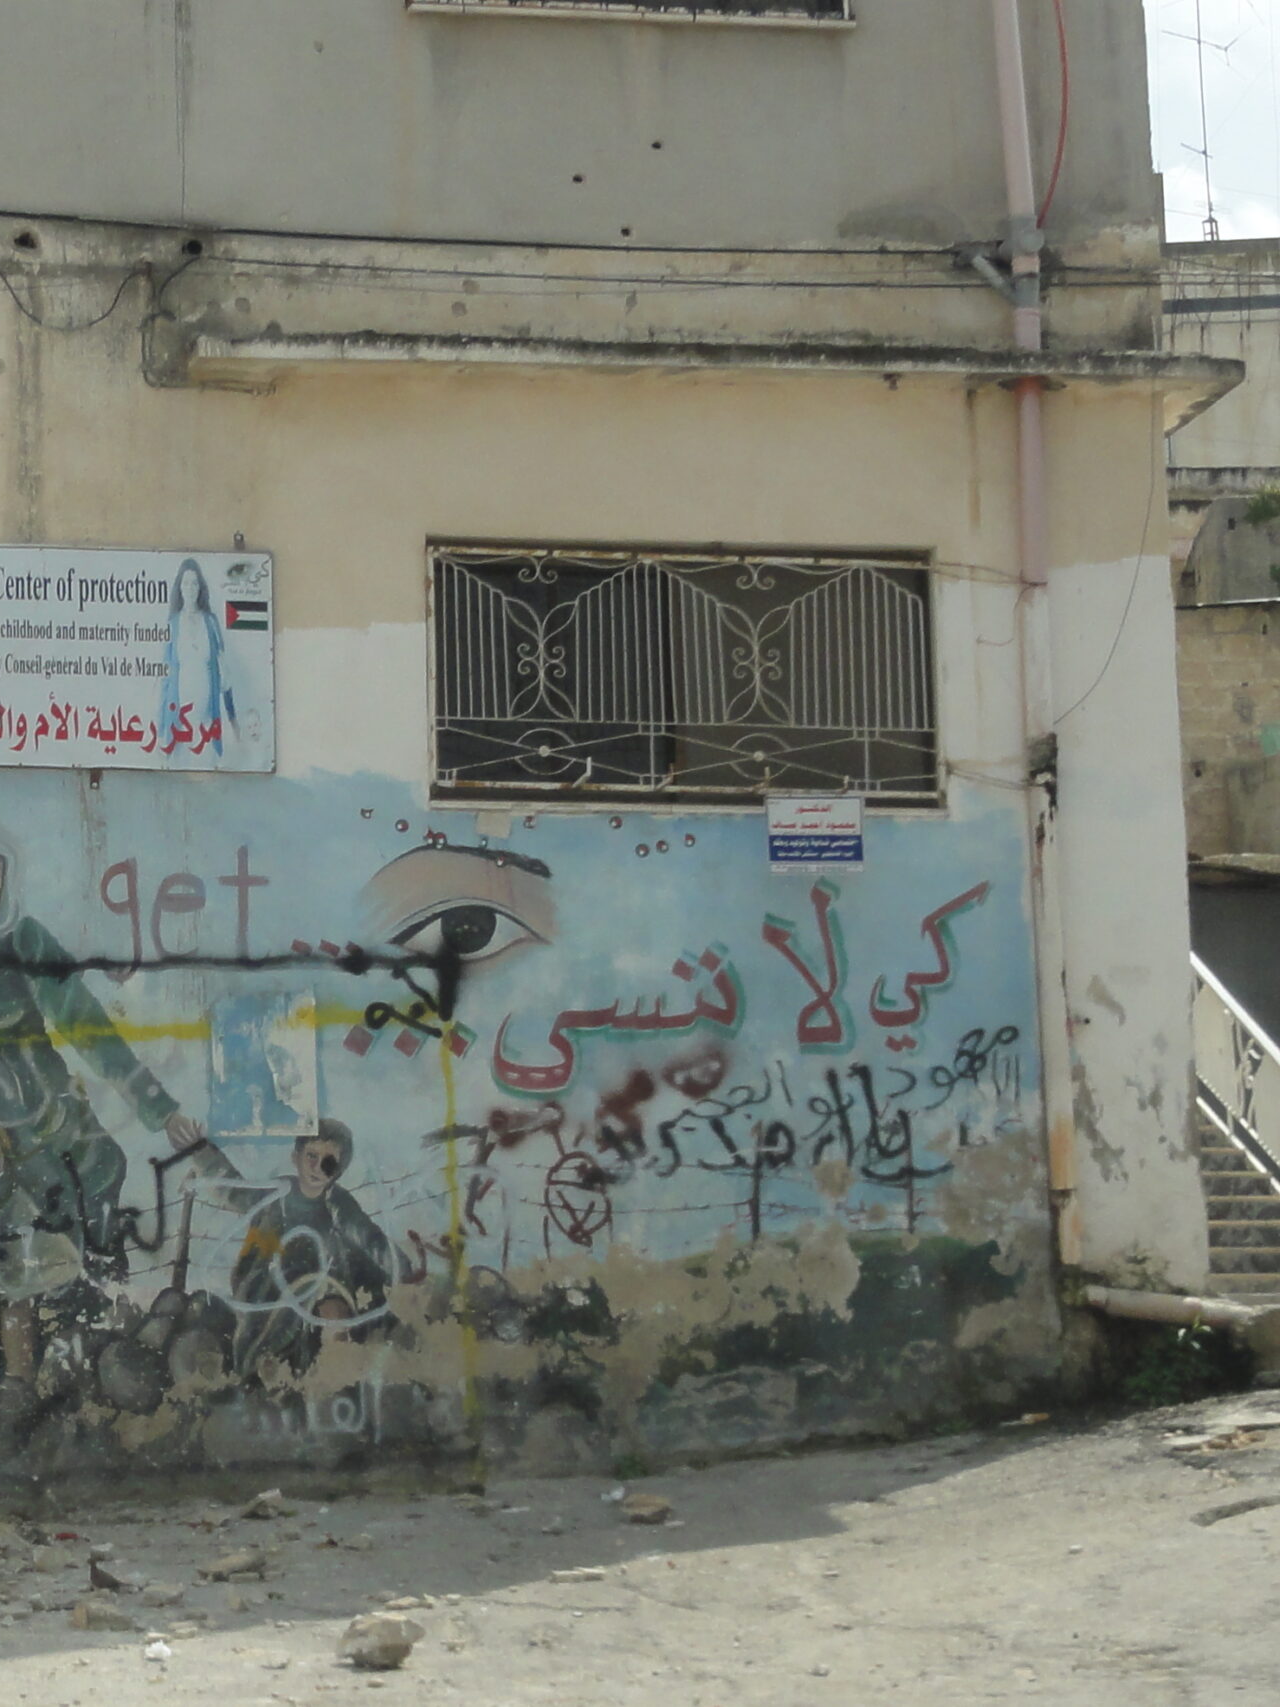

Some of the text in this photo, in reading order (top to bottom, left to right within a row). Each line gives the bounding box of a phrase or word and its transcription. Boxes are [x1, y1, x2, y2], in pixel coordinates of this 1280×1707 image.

[56, 567, 76, 602] of
[79, 569, 168, 612] protection
[0, 618, 53, 640] childhood
[56, 620, 76, 641] and
[79, 622, 130, 646] maternity
[133, 622, 171, 642] funded
[84, 656, 98, 676] du
[100, 656, 118, 676] Val
[120, 657, 132, 676] de
[135, 657, 169, 677] Marne
[85, 702, 158, 755] رعاية
[160, 702, 222, 755] مركز
[100, 845, 270, 982] get
[762, 877, 858, 1055] لا
